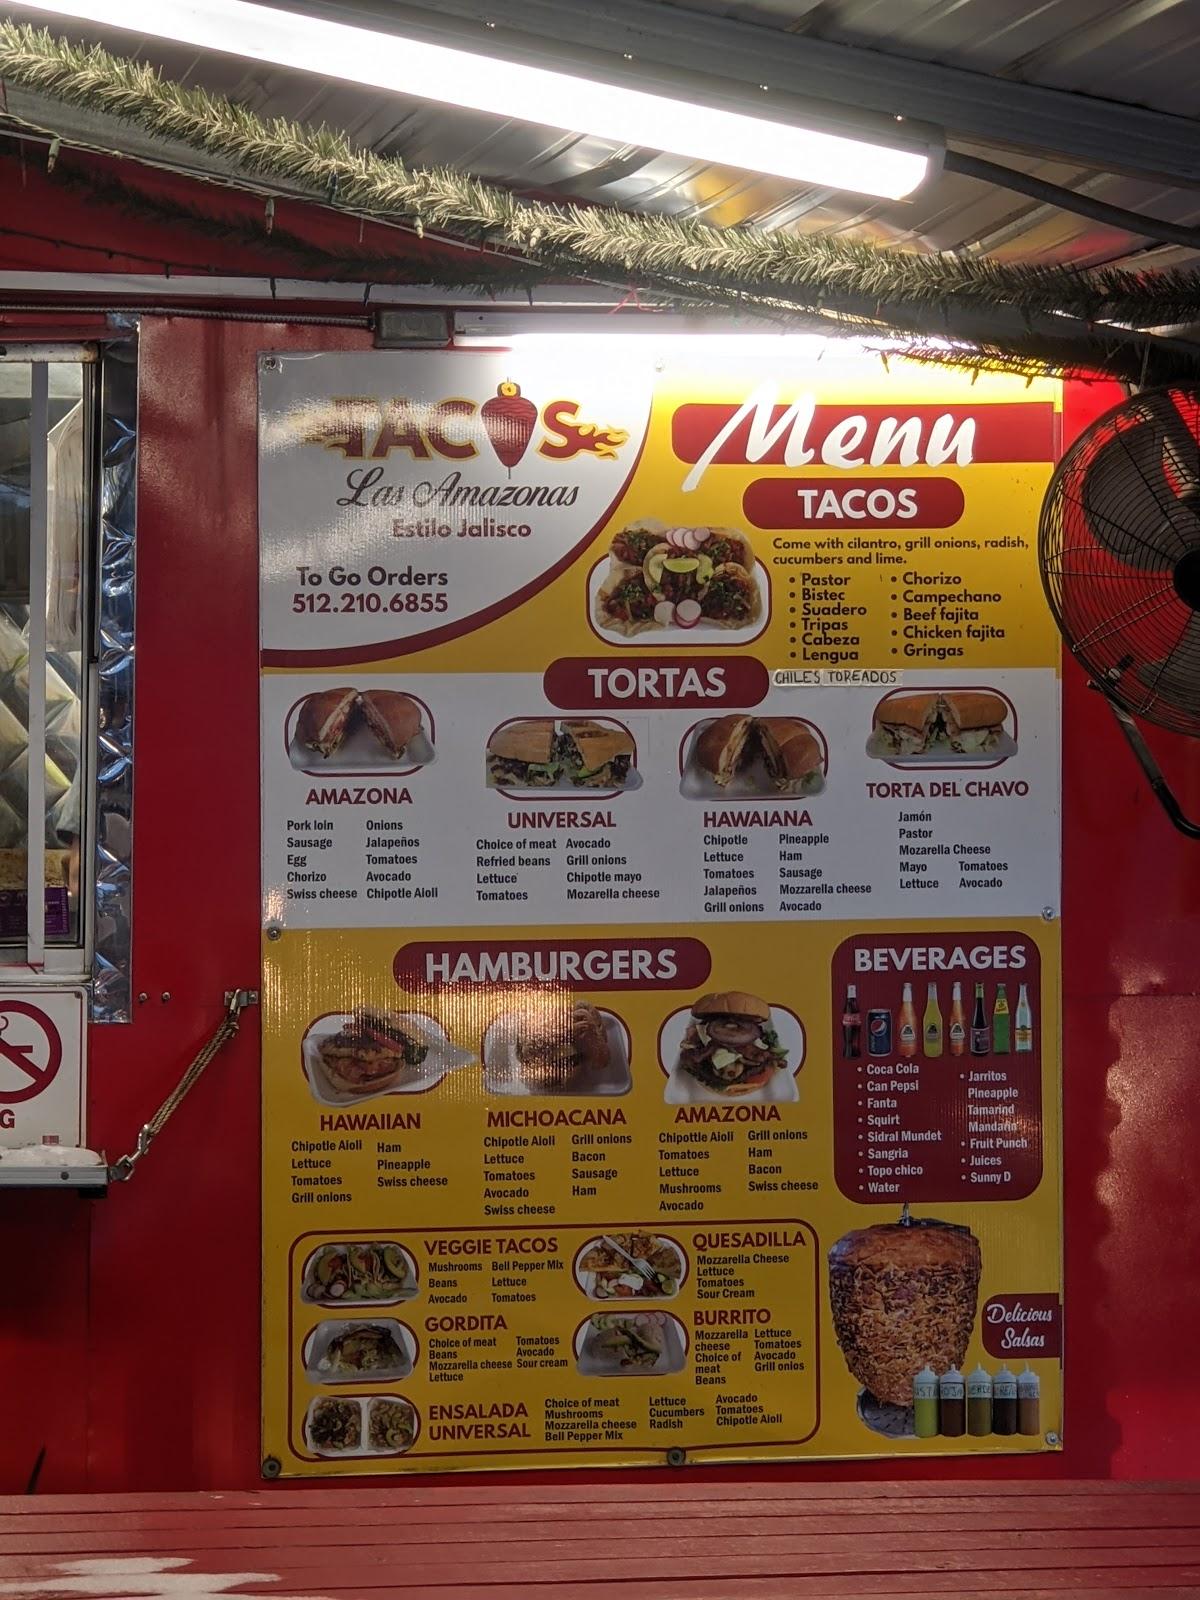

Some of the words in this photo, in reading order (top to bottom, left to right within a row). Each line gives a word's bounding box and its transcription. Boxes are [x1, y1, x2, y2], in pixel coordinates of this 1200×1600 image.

[681, 380, 976, 492] Menu
[336, 466, 405, 507] Las
[412, 471, 580, 508] Amazonas
[797, 488, 918, 519] TACOS
[392, 517, 452, 538] Estilo
[456, 517, 532, 538] Jalisco
[772, 537, 811, 550] Come
[814, 537, 844, 550] with
[847, 536, 902, 551] cilantro,
[904, 536, 931, 552] grill
[934, 540, 981, 550] onions,
[984, 536, 1029, 549] radish,
[772, 552, 844, 565] cucumbers
[846, 552, 872, 565] and
[875, 552, 907, 564] lime.
[296, 566, 323, 587] To
[328, 566, 362, 587] Go
[367, 565, 449, 587] Orders
[801, 572, 851, 586] Pastor
[902, 572, 962, 585] Chorizo
[802, 587, 845, 601] Bistec
[902, 590, 1002, 606] Campechano
[292, 592, 448, 614] 512.210.6855
[802, 602, 867, 616] Suadero
[903, 607, 937, 621] Beef
[939, 607, 979, 624] fajita
[801, 617, 849, 634] Tripas
[801, 632, 860, 646] Cabeza
[903, 625, 962, 639] Chicken
[965, 625, 1005, 641] fajita
[802, 647, 859, 664] Lengua
[903, 643, 964, 659] Gringas
[587, 667, 727, 699] TORTAS
[774, 670, 821, 685] CHILES
[827, 669, 897, 684] TOREADOS
[305, 787, 413, 805] AMAZONA
[865, 782, 926, 799] TORTA
[929, 781, 961, 798] DEL
[964, 780, 1029, 797] CHAVO
[507, 811, 617, 829] UNIVERSAL
[703, 809, 814, 828] HAWAIANA
[898, 810, 932, 822] Jamón
[287, 819, 312, 831] Pork
[313, 819, 334, 831] loin
[366, 819, 404, 831] Onions
[779, 833, 830, 847] Pineapple
[898, 828, 933, 839] Pastor
[286, 837, 333, 850] Sausage
[365, 836, 420, 850] Jalapeños
[476, 838, 514, 850] Choice
[515, 838, 527, 850] of
[529, 838, 557, 850] meat
[565, 837, 611, 849] Avocado
[703, 834, 748, 848] Chipotle
[779, 850, 803, 861] Ham
[899, 844, 951, 856] Mozarella
[952, 843, 991, 855] Cheese
[287, 854, 307, 868] Egg
[365, 854, 418, 865] Tomatoes
[476, 855, 516, 867] Refried
[518, 855, 551, 866] beans
[566, 854, 589, 866] Grill
[591, 854, 627, 866] onions
[703, 851, 744, 863] Lettuce
[899, 861, 928, 874] Mayo
[958, 860, 1009, 872] Tomatoes
[286, 871, 327, 883] Chorizo
[366, 870, 412, 882] Avocado
[476, 873, 518, 884] Lettuce
[566, 871, 612, 885] Chipotle
[614, 873, 642, 884] mayo
[703, 868, 755, 880] Tomatoes
[779, 867, 823, 880] Sausage
[779, 883, 834, 895] Mozzarella
[835, 883, 872, 894] cheese
[899, 878, 939, 889] Lettuce
[959, 877, 1003, 888] Avocado
[286, 888, 317, 900] Swiss
[319, 887, 358, 899] cheese
[366, 887, 412, 901] Chipotle
[413, 887, 438, 898] Aioli
[476, 889, 529, 901] Tomatoes
[567, 888, 620, 900] Mozarella
[622, 887, 660, 899] cheese
[703, 884, 757, 898] Jalapeños
[704, 901, 727, 913] Grill
[728, 901, 765, 913] onions
[779, 900, 822, 912] Avocado
[854, 945, 1027, 972] BEVERAGES
[425, 948, 678, 983] HAMBURGERS
[866, 1063, 894, 1075] Coca
[895, 1063, 920, 1074] Cola
[968, 1070, 1007, 1082] Jarritos
[866, 1080, 888, 1092] Can
[890, 1080, 919, 1094] Pepsi
[968, 1086, 1019, 1101] Pineapple
[867, 1097, 898, 1109] Fanta
[674, 1105, 782, 1124] AMAZONA
[967, 1103, 1015, 1117] Tamarind
[320, 1112, 421, 1132] HAWAIIAN
[487, 1108, 627, 1128] MICHOACANA
[867, 1114, 901, 1128] Squirt
[658, 1131, 708, 1145] Chipottle
[710, 1131, 734, 1142] Aioli
[867, 1130, 899, 1143] Sidral
[901, 1130, 942, 1142] Mundet
[970, 1137, 994, 1149] Fruit
[995, 1137, 1028, 1149] Punch
[377, 1142, 402, 1153] Ham
[748, 1147, 773, 1158] Ham
[867, 1147, 909, 1161] Sangria
[571, 1151, 606, 1162] Bacon
[969, 1154, 1002, 1166] Juices
[291, 1158, 332, 1169] Lettuce
[377, 1158, 431, 1172] Pineapple
[748, 1163, 782, 1175] Bacon
[571, 1168, 618, 1181] Sausage
[867, 1165, 893, 1178] Topo
[894, 1164, 924, 1176] chico
[970, 1171, 1002, 1185] Sunny
[1003, 1171, 1012, 1182] D
[572, 1185, 597, 1196] Ham
[659, 1183, 722, 1194] Mushrooms
[867, 1182, 900, 1193] Water
[659, 1199, 704, 1211] Avocado
[423, 1238, 492, 1256] VEGGIE
[495, 1236, 559, 1254] TACOS
[692, 1230, 807, 1252] QUESADILLA
[696, 1254, 751, 1266] Mozzarella
[752, 1253, 790, 1264] Cheese
[428, 1261, 483, 1272] Mushrooms
[428, 1278, 458, 1289] Beans
[693, 1308, 771, 1326] BURRITO
[986, 1302, 1052, 1324] Delicious
[424, 1314, 508, 1333] GORDITA
[695, 1329, 749, 1341] Mozzarella
[1000, 1327, 1045, 1349] Salsas
[694, 1341, 731, 1352] cheese
[428, 1349, 458, 1360] Beans
[516, 1358, 538, 1369] Sour
[539, 1359, 568, 1368] cream
[754, 1361, 776, 1372] Grill
[429, 1402, 529, 1421] ENSALADA
[649, 1407, 705, 1418] Cucumbers
[649, 1418, 683, 1429] Radish
[429, 1422, 532, 1441] UNIVERSAL
